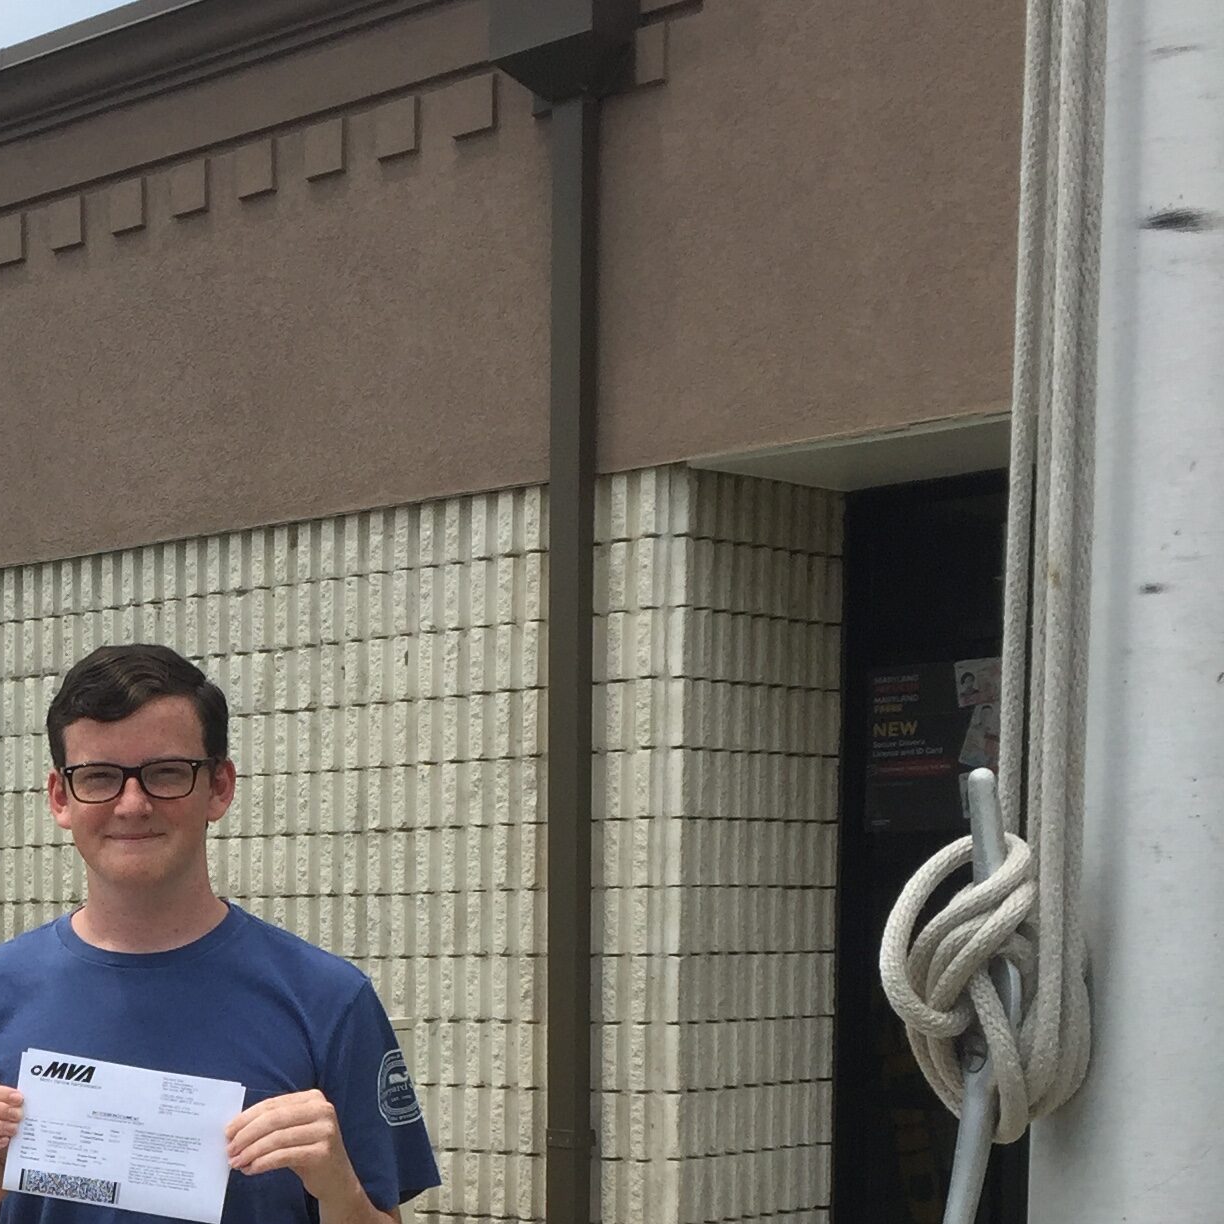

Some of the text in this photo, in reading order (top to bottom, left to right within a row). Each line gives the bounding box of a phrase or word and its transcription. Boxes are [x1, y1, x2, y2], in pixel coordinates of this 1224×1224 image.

[873, 720, 918, 737] NEW
[925, 746, 944, 754] Card
[42, 1061, 97, 1083] MVA
